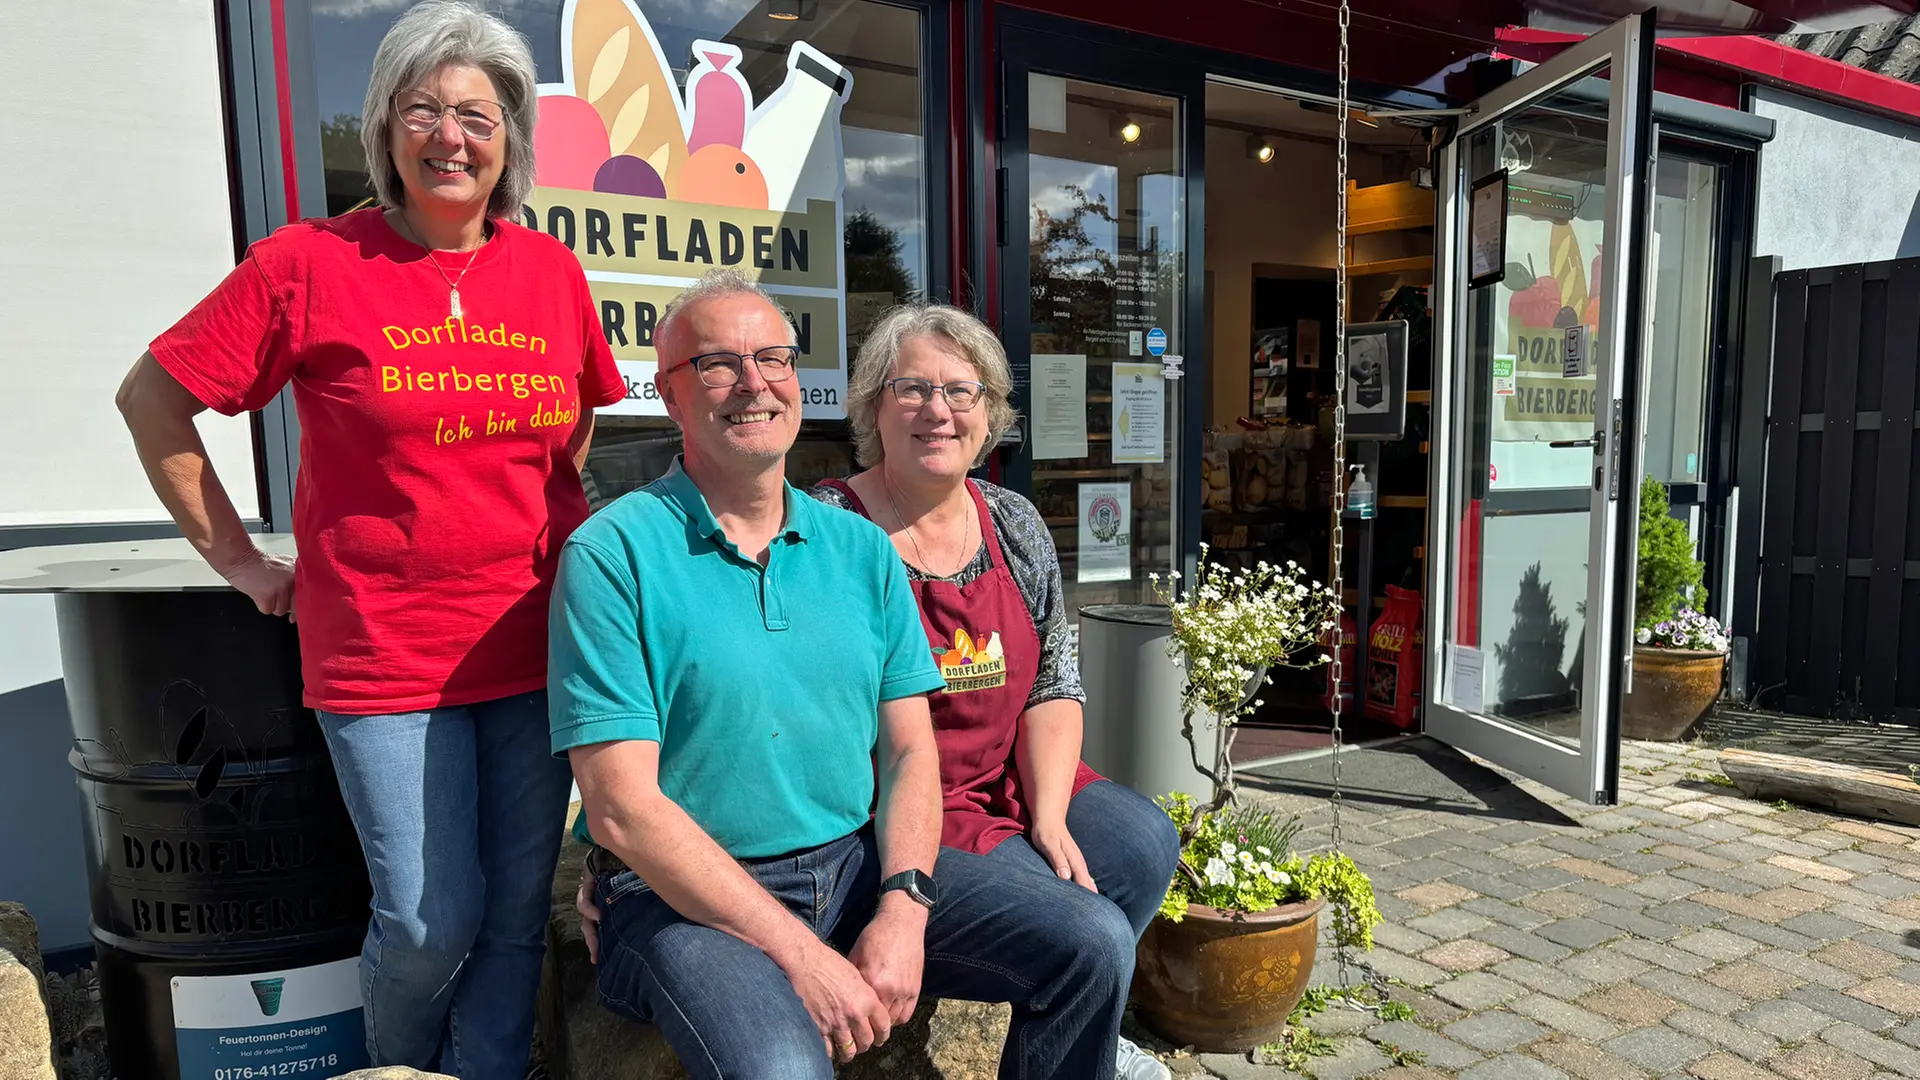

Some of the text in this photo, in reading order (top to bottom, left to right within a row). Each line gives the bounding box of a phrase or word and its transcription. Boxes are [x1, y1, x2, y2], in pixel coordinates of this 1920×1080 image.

[382, 316, 547, 354] Dorfladen
[381, 366, 566, 399] Bierbergen
[1516, 386, 1596, 415] BIERBERG
[435, 397, 579, 446] Ich bin dabei!
[1372, 633, 1405, 652] HOLZ
[945, 661, 1001, 676] DORFLADEN
[947, 676, 1001, 692] BIERBERGEN
[123, 833, 317, 874] DORFLAD
[131, 898, 324, 936] BIERBERG
[219, 1024, 327, 1045] Feuertonnen-Design
[215, 1053, 338, 1080] 0176-41275718
[240, 1050, 253, 1058] Hol
[253, 1048, 263, 1056] dir
[264, 1047, 284, 1055] deine
